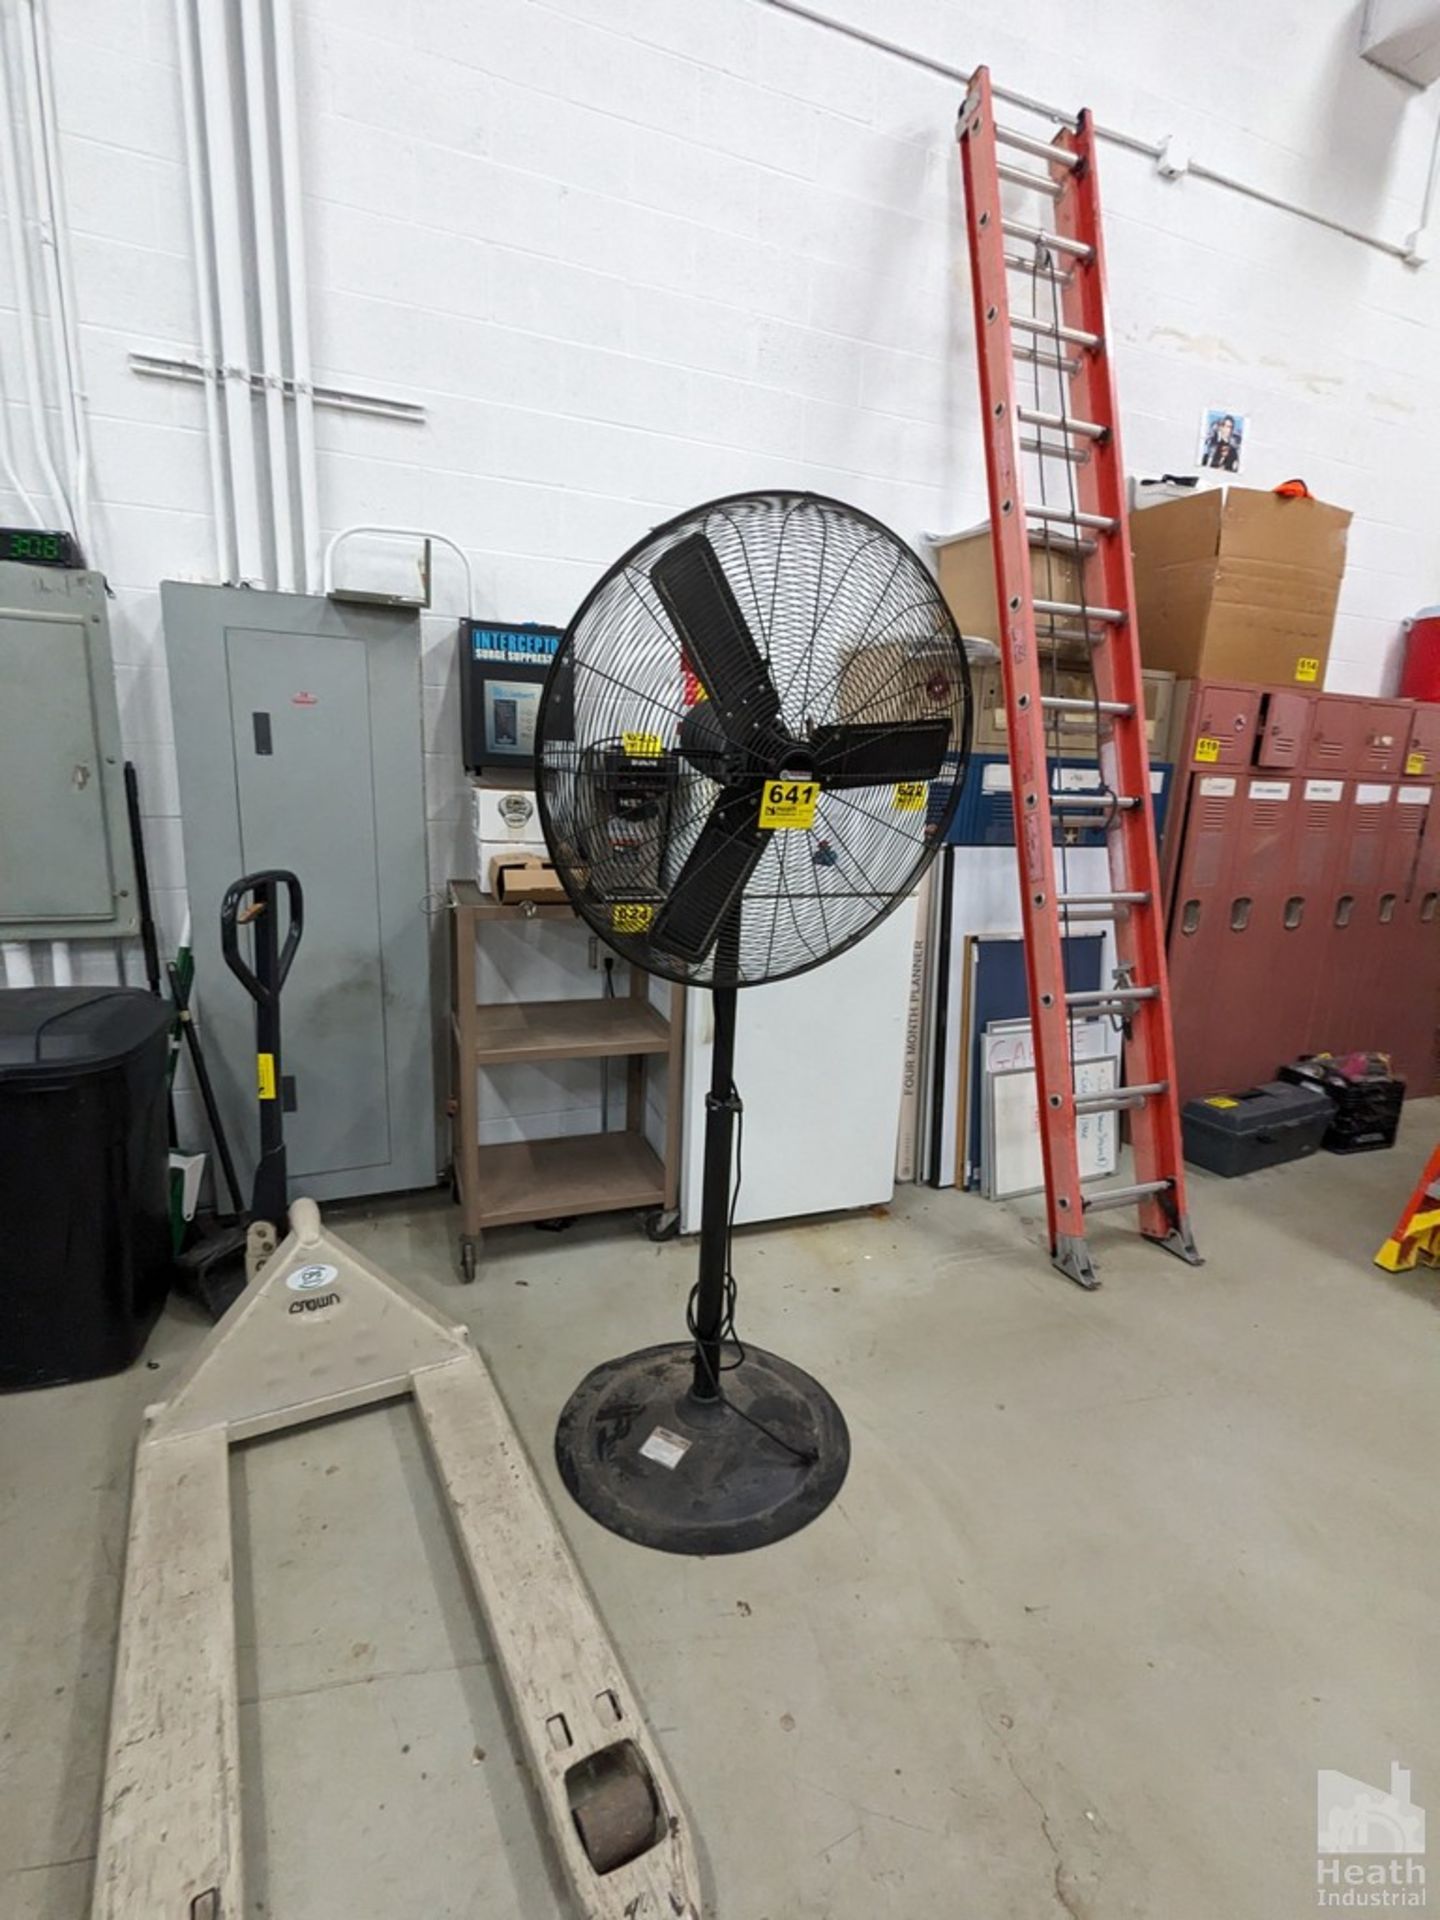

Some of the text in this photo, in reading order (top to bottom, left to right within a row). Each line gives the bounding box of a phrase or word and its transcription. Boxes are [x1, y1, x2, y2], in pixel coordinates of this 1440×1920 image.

[475, 648, 506, 660] SURGE
[769, 783, 813, 805] 641
[903, 939, 925, 1096] FOUR MONTH PLANNER
